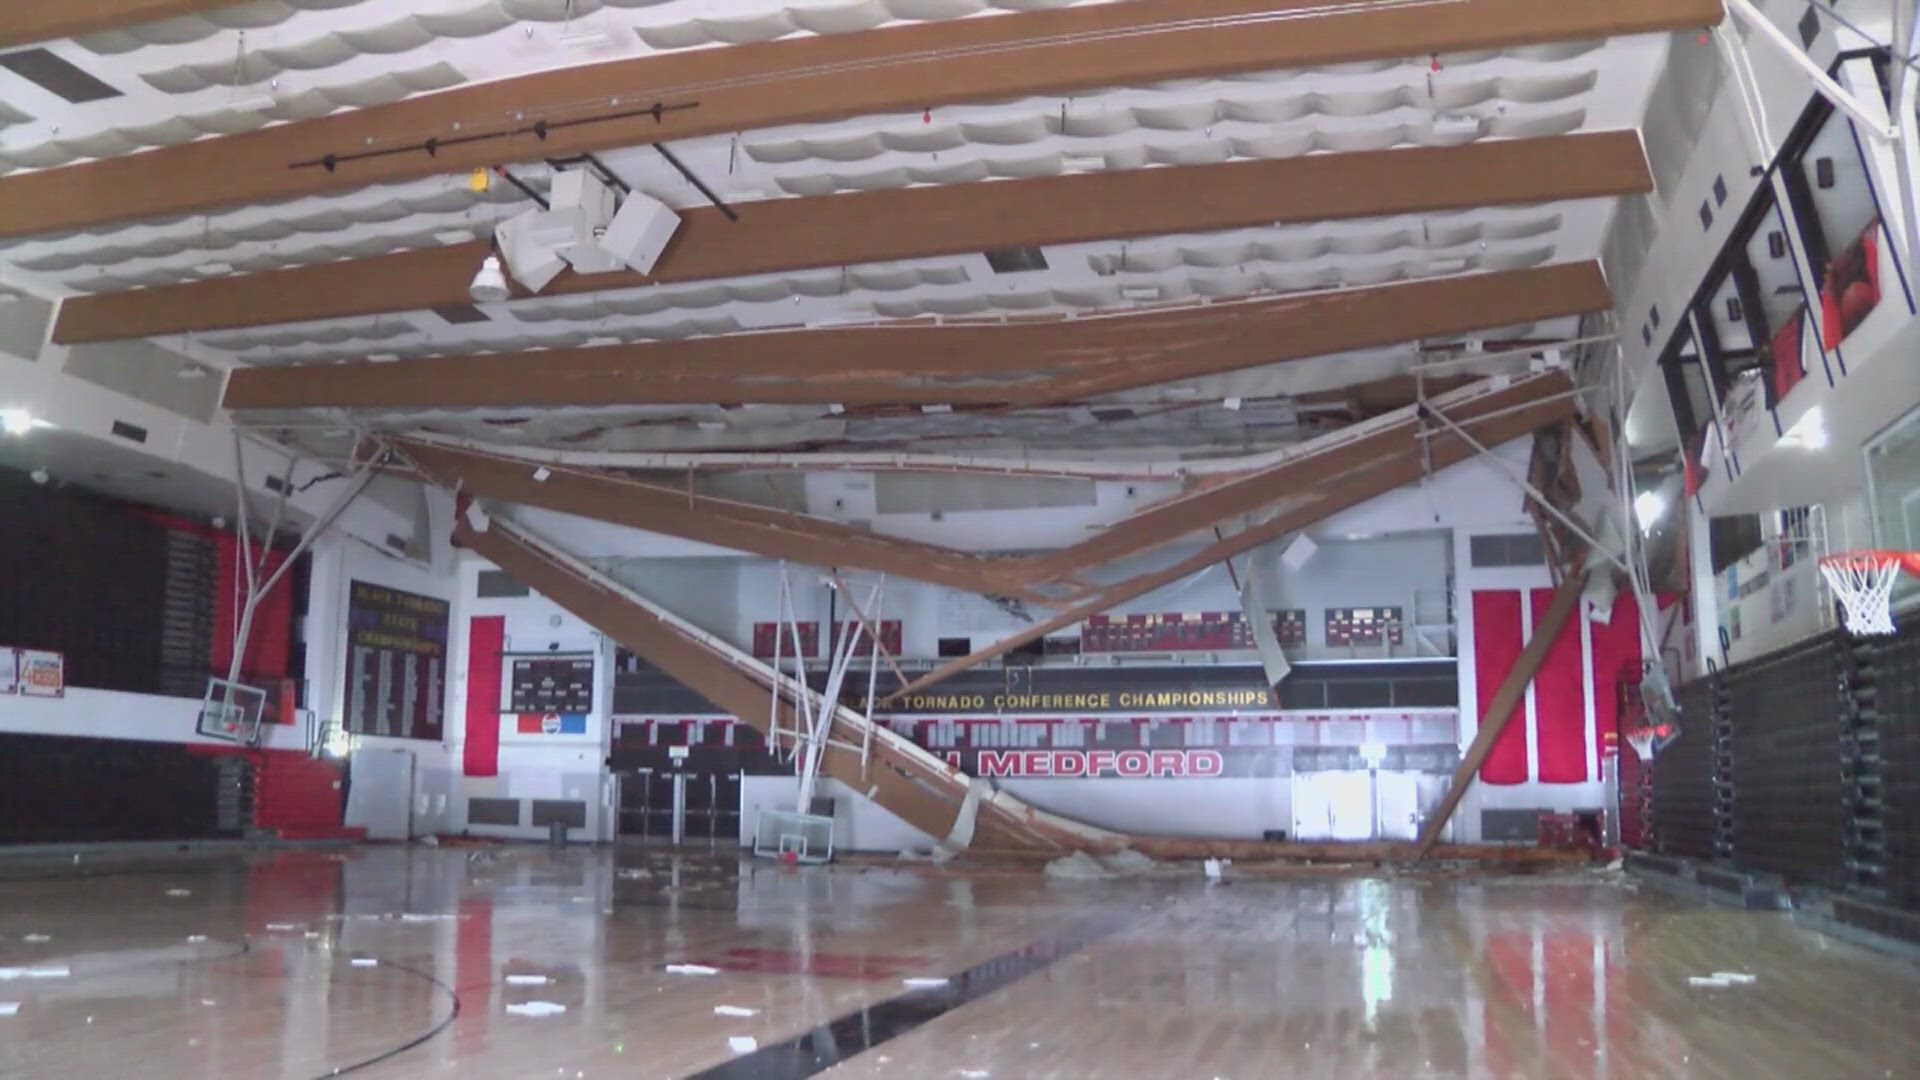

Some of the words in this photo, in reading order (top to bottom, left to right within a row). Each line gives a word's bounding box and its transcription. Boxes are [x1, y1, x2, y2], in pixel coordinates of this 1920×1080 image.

[902, 695, 985, 709] TORNADO
[993, 693, 1110, 709] CONFERENCE
[1119, 691, 1268, 707] CHAMPIONSHIPS
[977, 750, 1224, 777] MEDFORD
